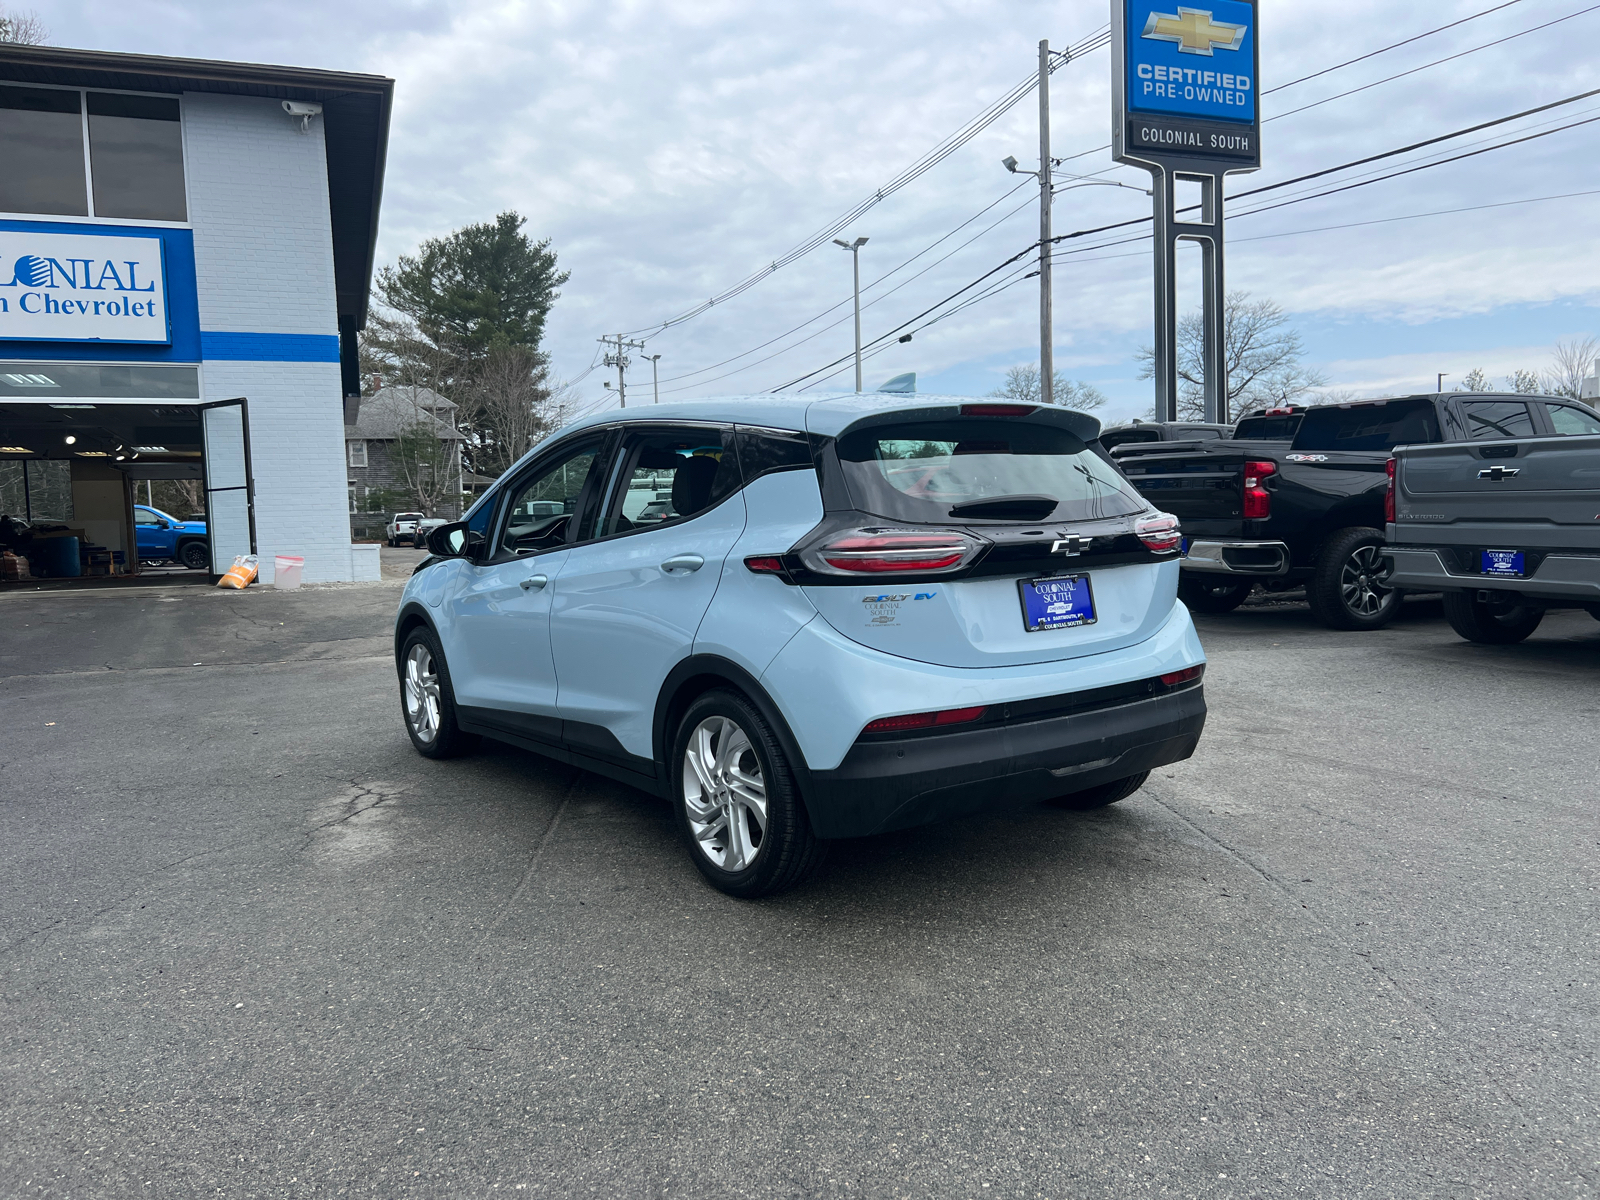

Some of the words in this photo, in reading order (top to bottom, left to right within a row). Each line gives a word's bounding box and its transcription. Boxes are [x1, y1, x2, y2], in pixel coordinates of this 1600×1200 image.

[1137, 63, 1250, 91] CERTIFIED
[1143, 81, 1245, 106] PRE-OWNED
[1141, 127, 1203, 146] COLONIAL
[1210, 134, 1249, 150] SOUTH
[19, 292, 157, 318] Chevrolet
[862, 593, 911, 603] BOLT
[914, 592, 937, 601] EV
[1035, 582, 1076, 595] COLONIAL
[1043, 591, 1072, 604] SOUTH
[864, 602, 902, 610] COLONIAL
